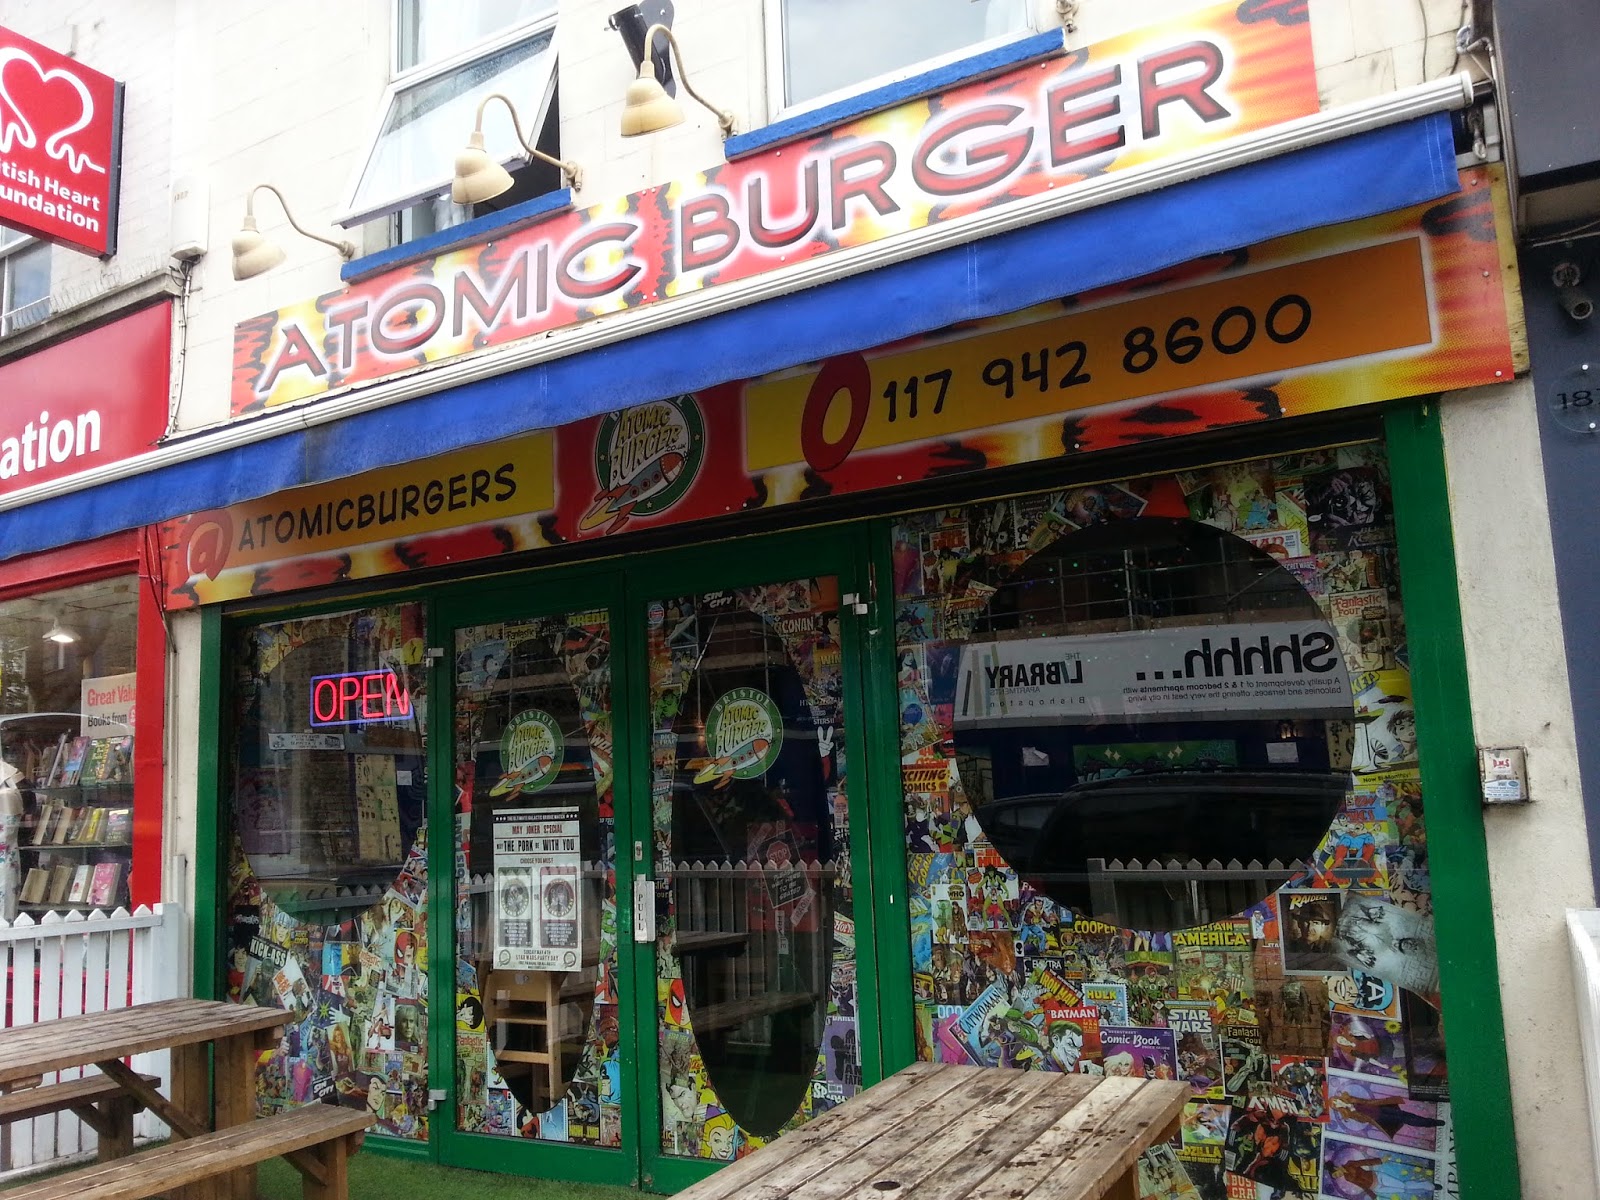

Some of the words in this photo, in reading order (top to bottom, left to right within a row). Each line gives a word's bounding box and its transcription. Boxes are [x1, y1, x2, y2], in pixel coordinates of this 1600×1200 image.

[0, 160, 40, 189] tish
[44, 176, 100, 211] Heart
[259, 222, 642, 393] ATOMIC
[680, 40, 1232, 272] BURGER
[982, 341, 1091, 398] 942
[1122, 295, 1312, 373] 8600
[615, 404, 673, 448] ATOMIC
[0, 408, 101, 481] ation
[611, 425, 682, 482] BURGER
[703, 590, 724, 604] SIN
[709, 596, 733, 609] CITY
[782, 616, 814, 633] CONAN
[1351, 671, 1381, 694] KETS
[88, 688, 116, 706] Great
[314, 672, 410, 721] OPEN
[714, 690, 770, 712] BRISTOL
[88, 714, 111, 727] Books
[112, 713, 127, 725] from
[508, 711, 553, 732] BRISTOL
[720, 703, 760, 730] ATOMIC
[513, 724, 545, 745] ATOMIC
[717, 719, 768, 754] BURGER
[509, 739, 550, 771] BURGER
[902, 769, 946, 782] XCITING
[512, 826, 523, 834] MAY
[526, 825, 540, 834] JOKER
[544, 824, 563, 833] SPECIAL
[504, 840, 514, 851] THE
[518, 839, 533, 851] PORK
[543, 839, 559, 851] WITH
[563, 839, 575, 850] YOU
[769, 848, 787, 861] STOP
[978, 856, 1010, 868] HUL
[1289, 894, 1328, 910] RAIDERS
[1074, 920, 1117, 934] COOPER
[1175, 932, 1247, 946] AMERICA
[249, 939, 286, 967] KICK-ASS
[1040, 972, 1061, 994] IRON
[1055, 987, 1080, 1007] MAN
[1087, 989, 1117, 1000] HULK
[961, 990, 1002, 1035] CATWOMAN
[1051, 1008, 1097, 1019] BATMAN
[1168, 1009, 1212, 1020] STAR
[1170, 1020, 1212, 1032] WARS
[1228, 1027, 1259, 1038] Fantasti
[1100, 1031, 1130, 1044] Comic
[1133, 1034, 1160, 1048] Book
[313, 1081, 327, 1093] SIN
[319, 1084, 334, 1097] CITY
[1250, 1096, 1299, 1114] X-MEN
[1231, 1175, 1256, 1187] BUS
[1232, 1187, 1257, 1200] CRA
